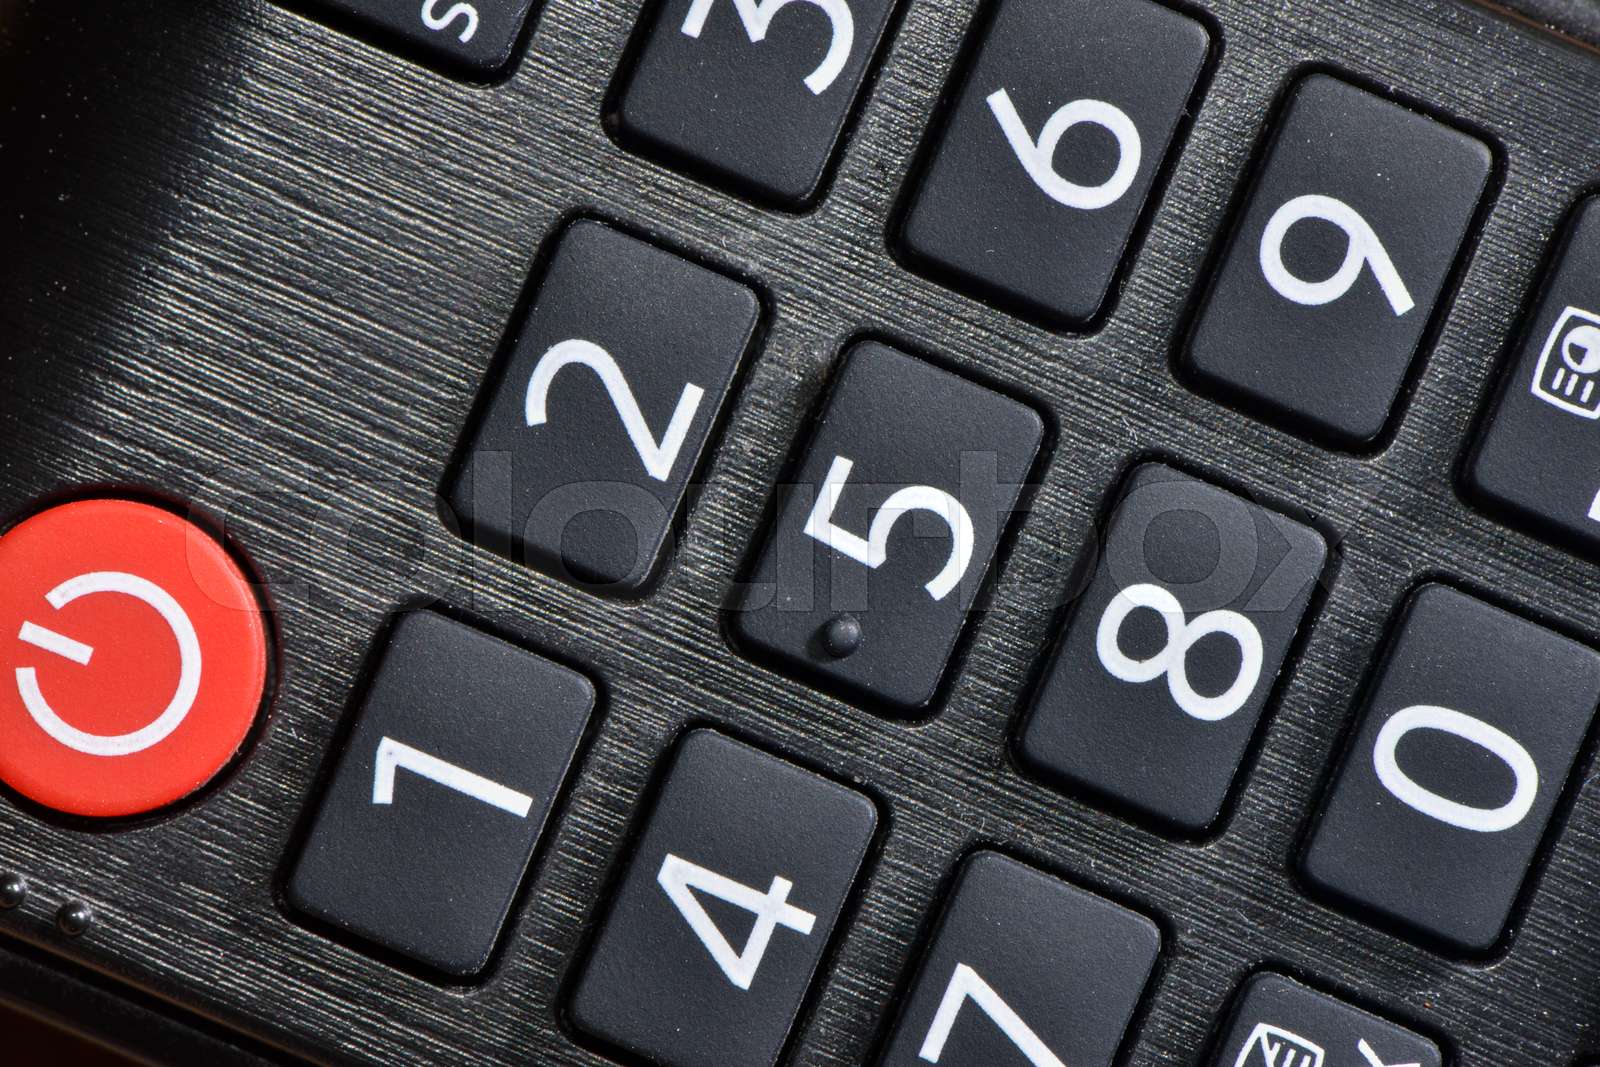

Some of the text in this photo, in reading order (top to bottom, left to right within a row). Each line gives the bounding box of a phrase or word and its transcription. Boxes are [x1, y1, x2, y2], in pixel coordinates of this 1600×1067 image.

[682, 0, 855, 96] 3
[987, 88, 1142, 210] 6
[1260, 194, 1416, 317] 9
[526, 339, 705, 482] 2
[804, 456, 975, 601] 5
[1097, 584, 1264, 721] 8
[373, 736, 534, 818] 1
[658, 853, 817, 991] 4
[918, 962, 1067, 1067] 7
